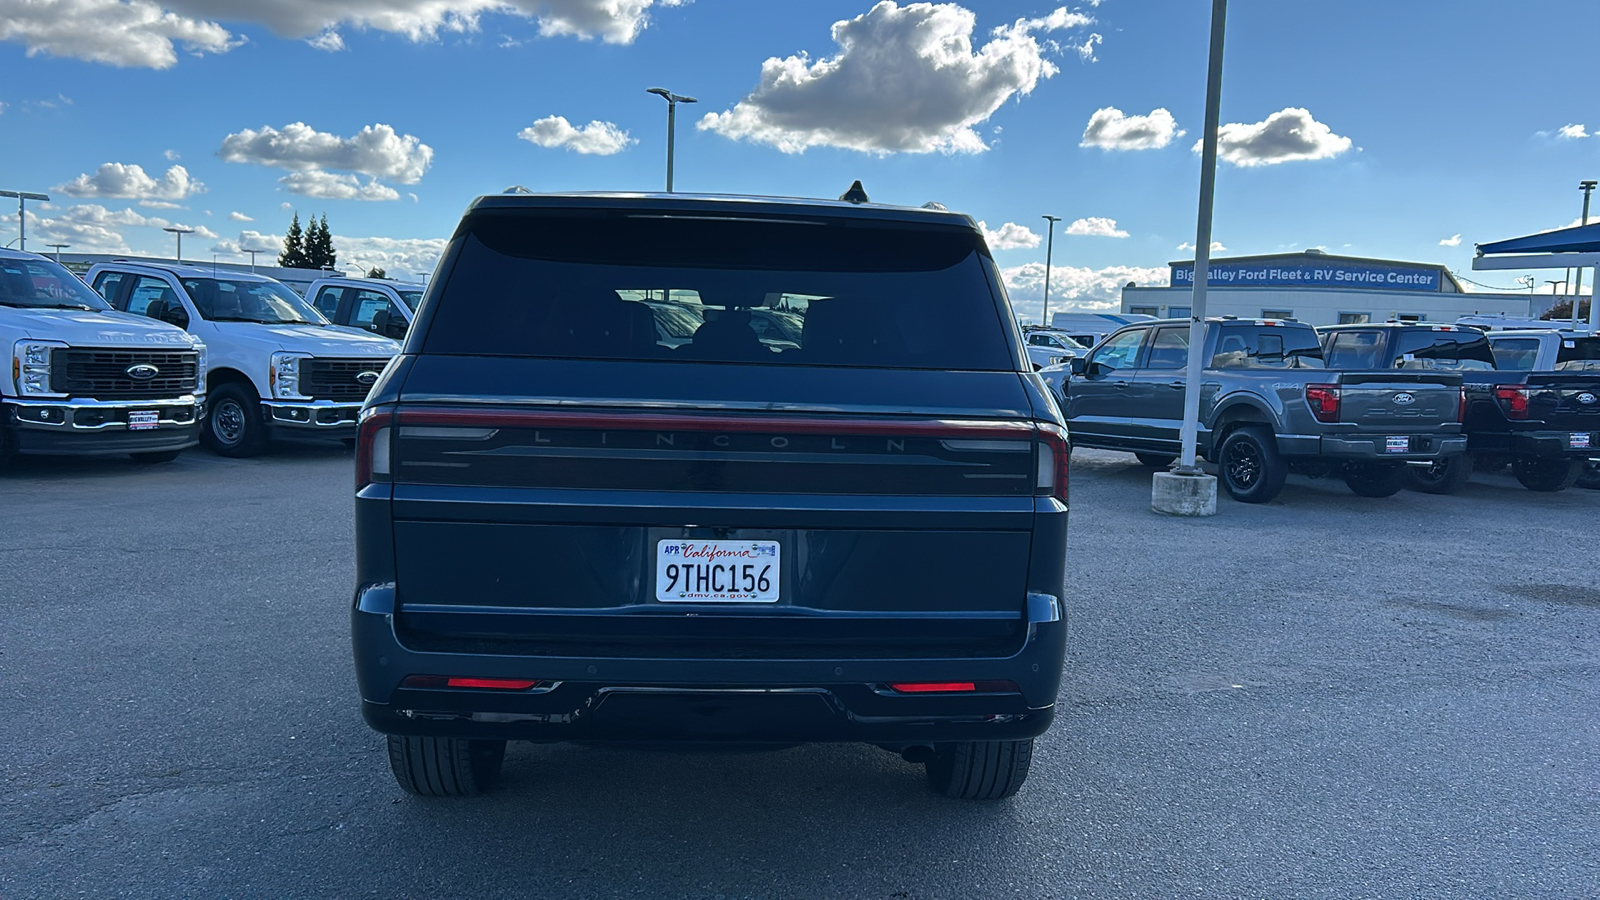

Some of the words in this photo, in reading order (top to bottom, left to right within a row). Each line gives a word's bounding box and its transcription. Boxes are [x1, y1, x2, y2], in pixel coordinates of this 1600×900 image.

[1206, 269, 1236, 281] alley
[1238, 269, 1267, 280] Ford
[1269, 269, 1302, 280] Fleet
[1303, 271, 1311, 280] &
[1314, 269, 1333, 280] RV
[1335, 270, 1385, 283] Service
[1387, 272, 1433, 285] Center
[534, 431, 906, 452] LINCOLN
[664, 545, 680, 555] APR
[683, 543, 760, 563] California
[664, 564, 772, 593] 9THC156
